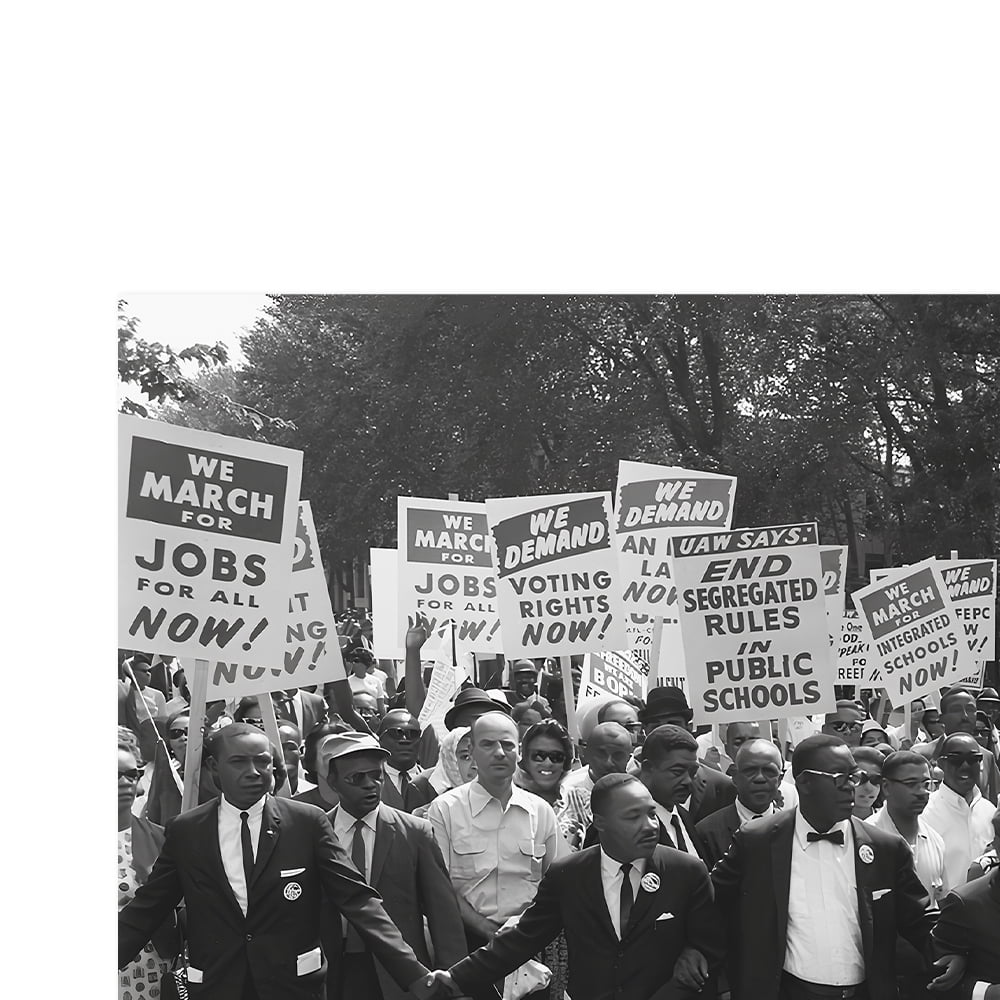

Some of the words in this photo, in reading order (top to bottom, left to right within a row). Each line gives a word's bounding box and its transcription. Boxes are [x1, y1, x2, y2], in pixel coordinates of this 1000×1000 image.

[187, 453, 234, 482] WE
[139, 471, 274, 520] MARCH
[654, 480, 697, 503] WE
[181, 510, 233, 531] FOR
[443, 514, 473, 531] WE
[530, 506, 570, 536] WE
[623, 500, 724, 527] DEMAND
[504, 521, 605, 569] DEMAND
[621, 535, 656, 556] AN
[680, 534, 731, 555] UAW
[135, 538, 266, 587] JOBS
[441, 553, 475, 564] FOR
[641, 559, 671, 580] LA
[700, 554, 792, 583] END
[414, 573, 497, 598] JOBS
[508, 570, 612, 595] VOTING
[945, 567, 971, 585] WE
[948, 577, 991, 598] MAND
[137, 577, 194, 599] FOR
[210, 590, 259, 608] ALL
[622, 581, 679, 607] NO
[683, 578, 818, 613] SEGREGATED
[884, 582, 910, 601] WE
[417, 600, 453, 610] FOR
[464, 602, 496, 613] ALL
[519, 594, 610, 618] RIGHTS
[871, 586, 935, 626] MARCH
[894, 610, 921, 627] FOR
[954, 607, 991, 620] FEPC
[128, 605, 269, 651] NOW!
[521, 613, 613, 647] NOW!
[704, 606, 800, 637] RULES
[737, 640, 772, 655] IN
[876, 613, 950, 657] INTEGRATED
[884, 632, 958, 674] SCHOOLS
[705, 652, 813, 684] PUBLIC
[899, 649, 958, 696] NOW!
[703, 680, 821, 712] SCHOOLS
